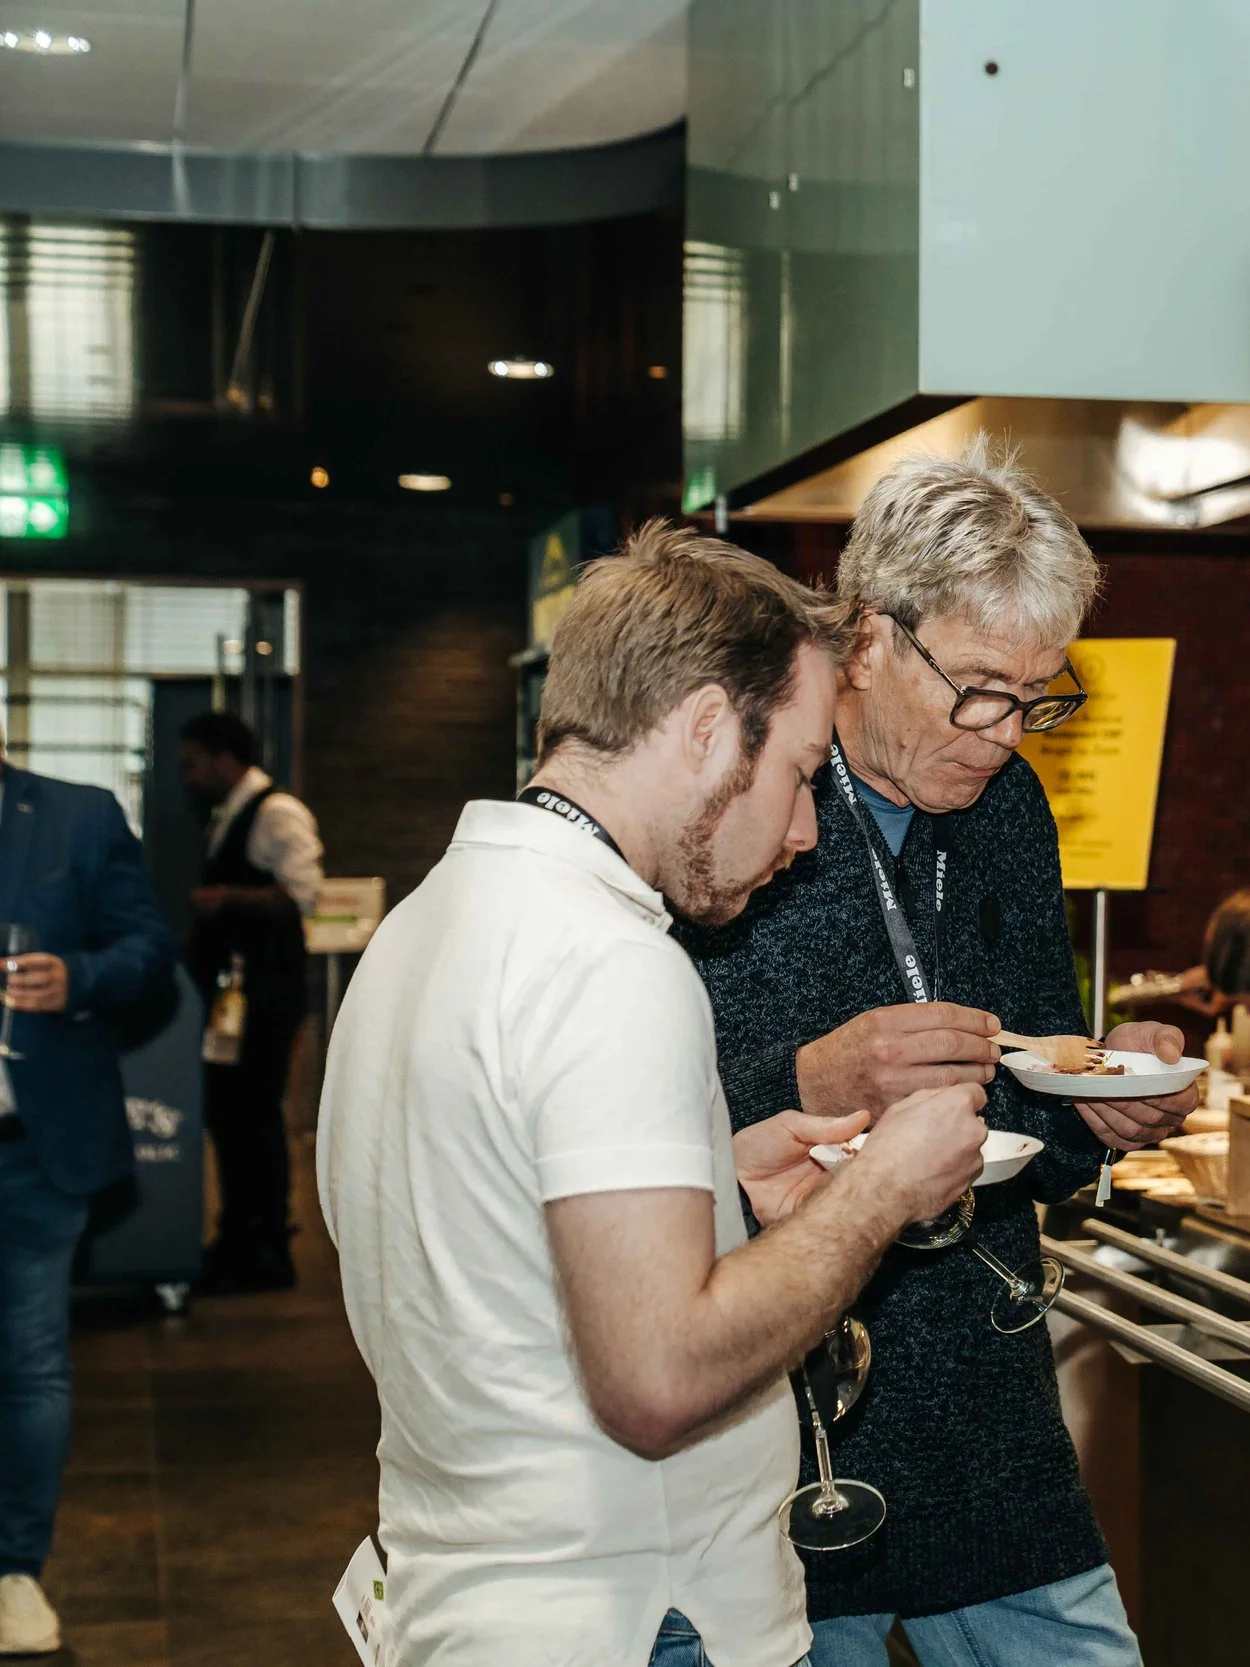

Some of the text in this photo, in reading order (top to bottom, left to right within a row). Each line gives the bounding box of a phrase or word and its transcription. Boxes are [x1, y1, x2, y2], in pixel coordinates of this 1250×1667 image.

[830, 743, 858, 806] Miele
[935, 849, 947, 912] Miele
[904, 954, 929, 1004] iele
